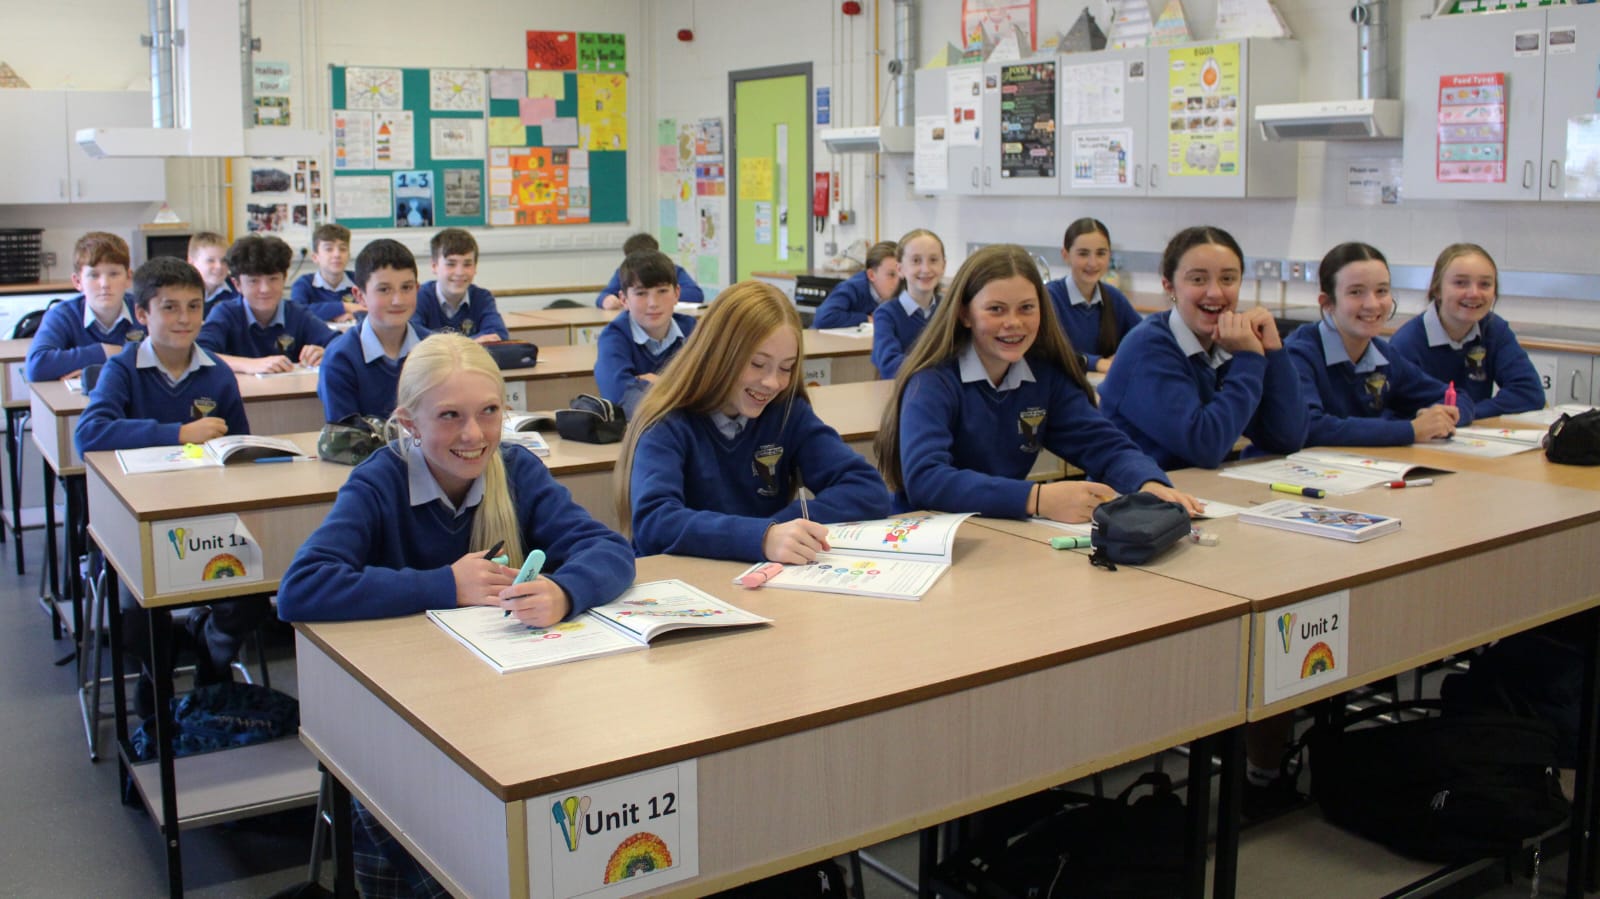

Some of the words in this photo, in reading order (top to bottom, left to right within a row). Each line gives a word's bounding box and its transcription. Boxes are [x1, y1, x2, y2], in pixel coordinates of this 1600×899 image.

[1453, 76, 1472, 85] Food
[1542, 375, 1551, 390] 3
[512, 391, 519, 402] 6
[188, 535, 224, 552] Unit
[229, 533, 249, 547] 11
[1301, 617, 1329, 640] Unit
[1330, 613, 1339, 632] 2
[585, 803, 640, 835] Unit
[647, 792, 677, 820] 12
